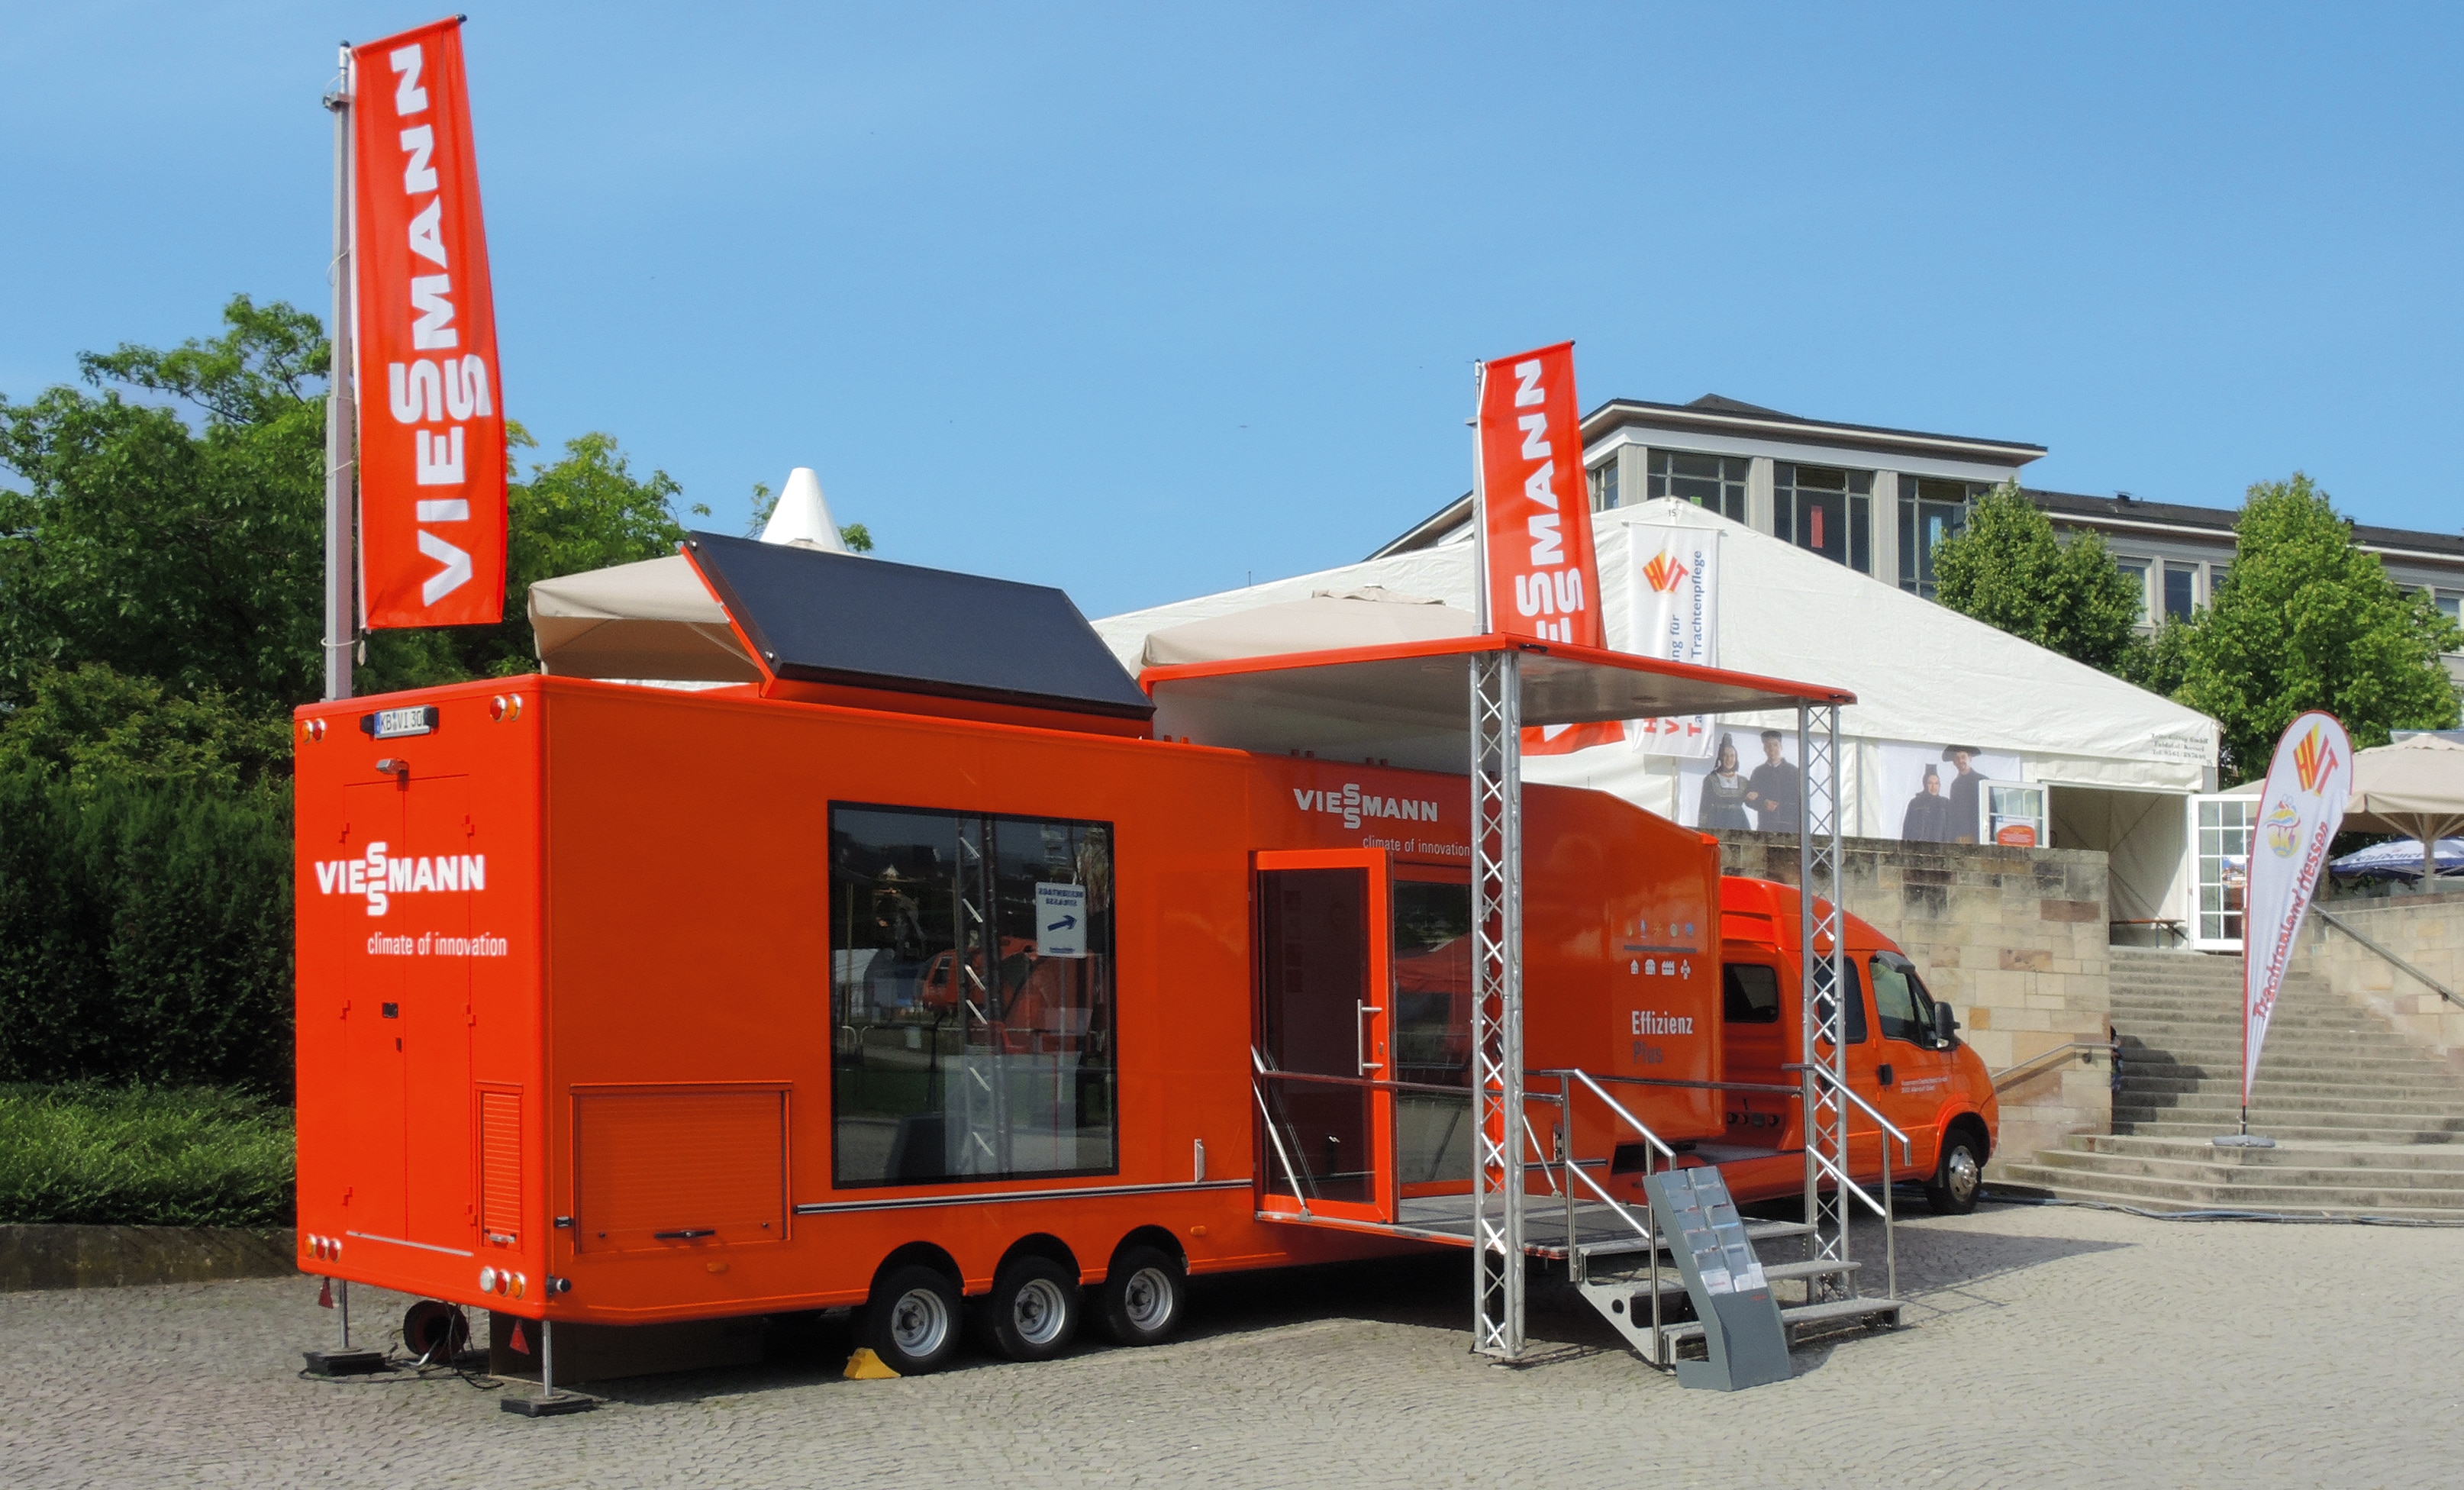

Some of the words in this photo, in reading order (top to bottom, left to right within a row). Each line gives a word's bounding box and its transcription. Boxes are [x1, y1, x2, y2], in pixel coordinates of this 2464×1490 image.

[388, 44, 492, 608] VIESSMANN
[1515, 358, 1585, 742] ESSMANN
[1670, 614, 1681, 636] für
[1691, 550, 1705, 658] Trachtenpflege
[381, 714, 392, 730] KB
[397, 711, 408, 729] VI
[411, 710, 425, 727] 30
[2293, 722, 2338, 795] HVT
[1293, 782, 1438, 830] VIESSMANN
[1363, 836, 1401, 851] climate
[1405, 838, 1415, 853] of
[1418, 839, 1470, 856] innovation
[2297, 821, 2329, 892] Hessen
[314, 841, 485, 917] VIESSMANN
[367, 932, 413, 956] climate
[418, 932, 431, 956] of
[435, 932, 507, 956] innovation
[1631, 1010, 1693, 1035] Effizienz
[1633, 1040, 1663, 1064] Plus
